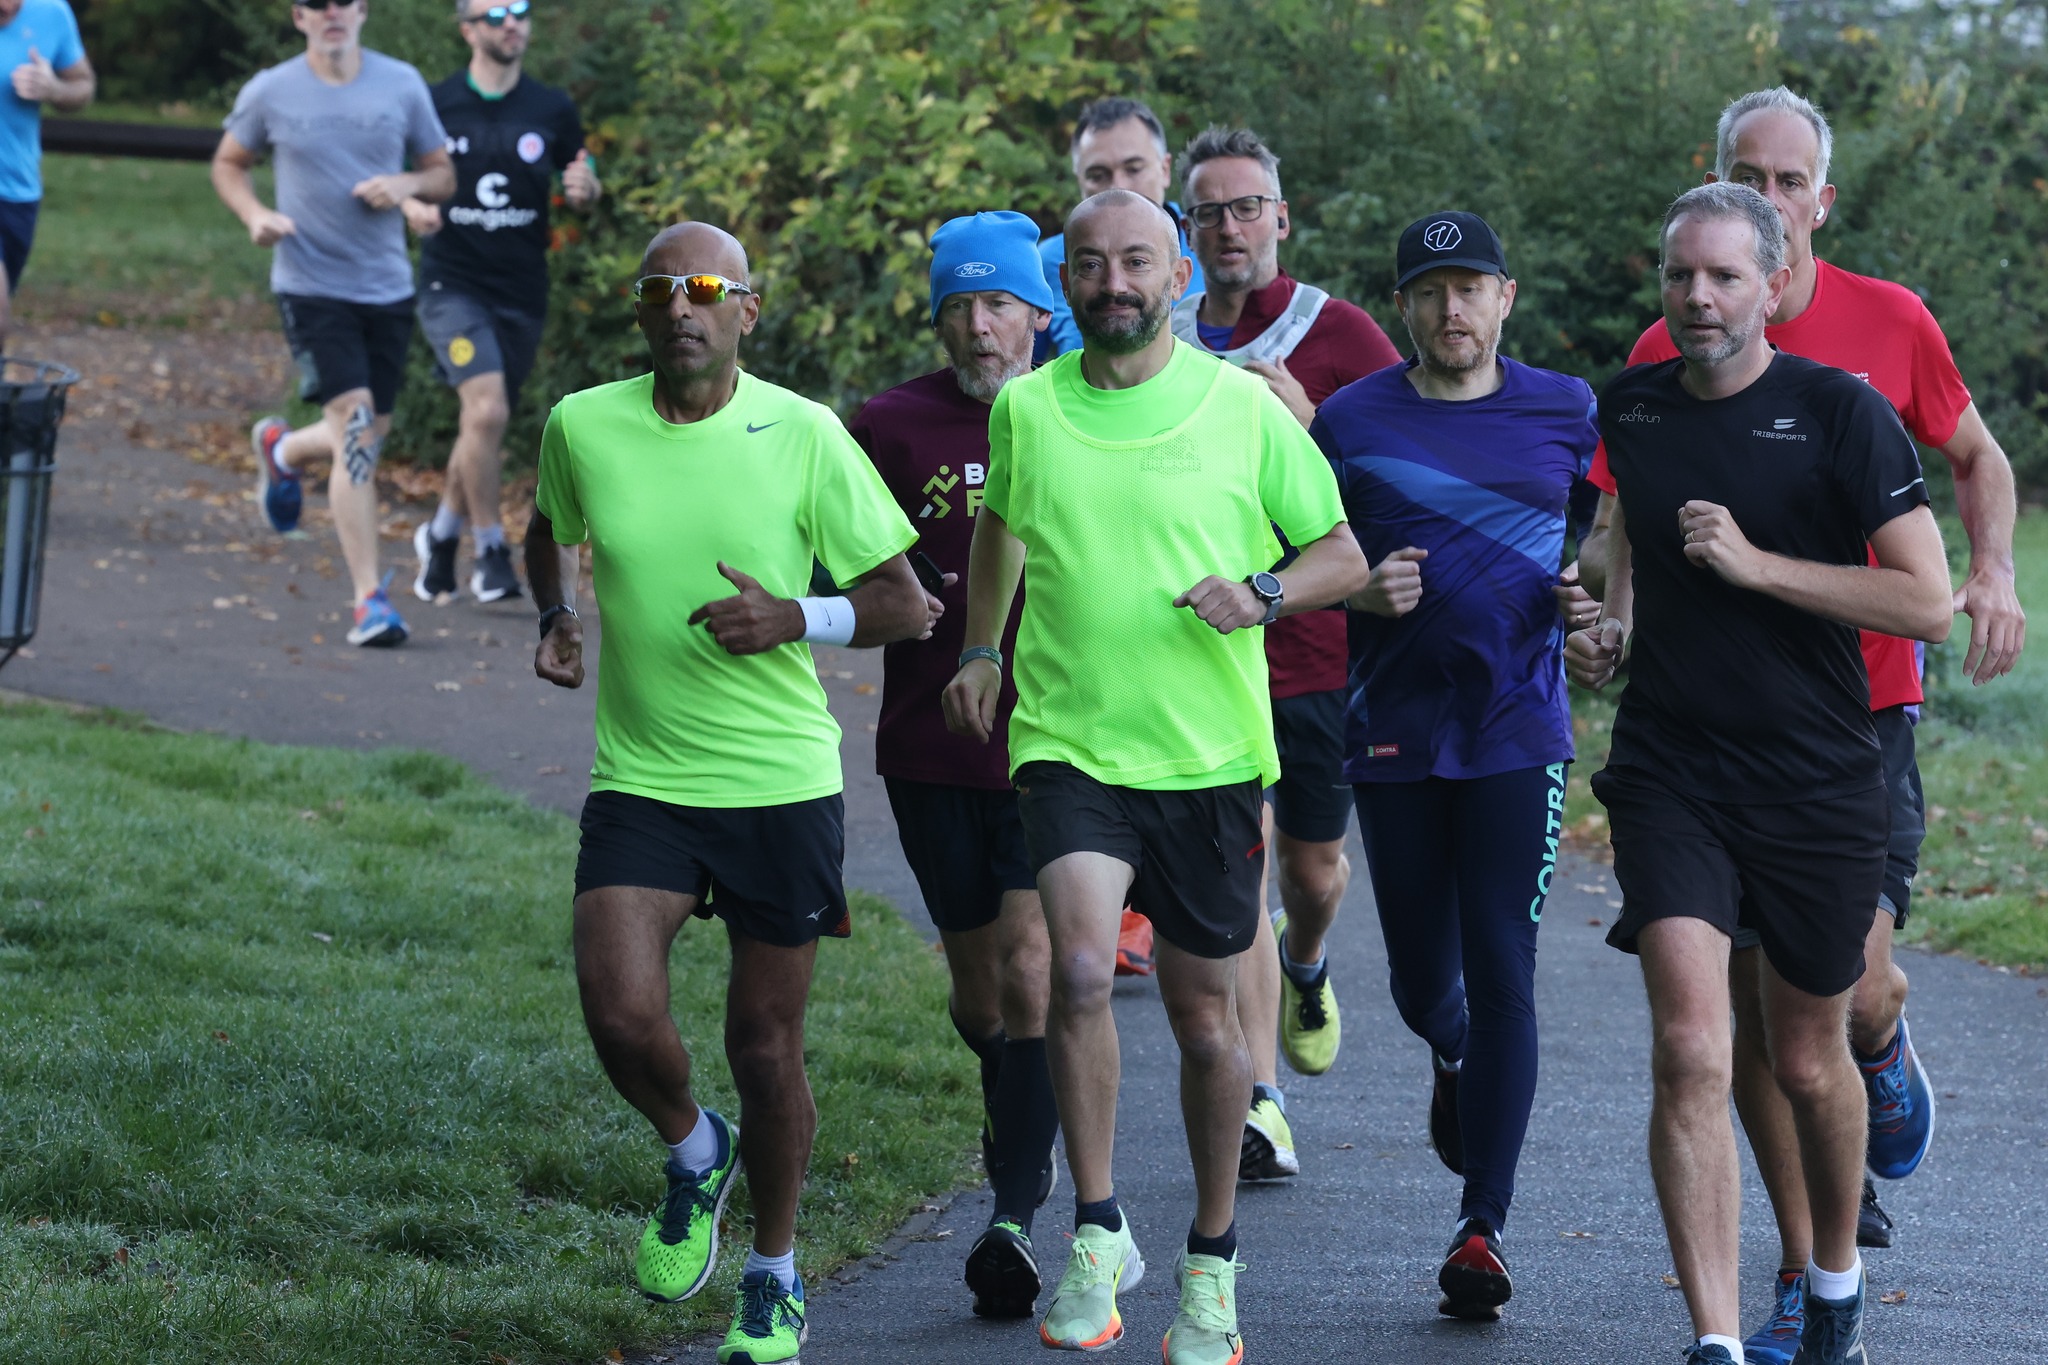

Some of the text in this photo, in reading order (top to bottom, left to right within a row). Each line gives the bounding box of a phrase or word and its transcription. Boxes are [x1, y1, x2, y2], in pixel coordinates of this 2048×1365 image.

[961, 264, 988, 275] Ford
[1618, 405, 1660, 423] parkrun
[1752, 429, 1807, 441] TRIBESPORTS
[1529, 761, 1565, 923] CONTRA
